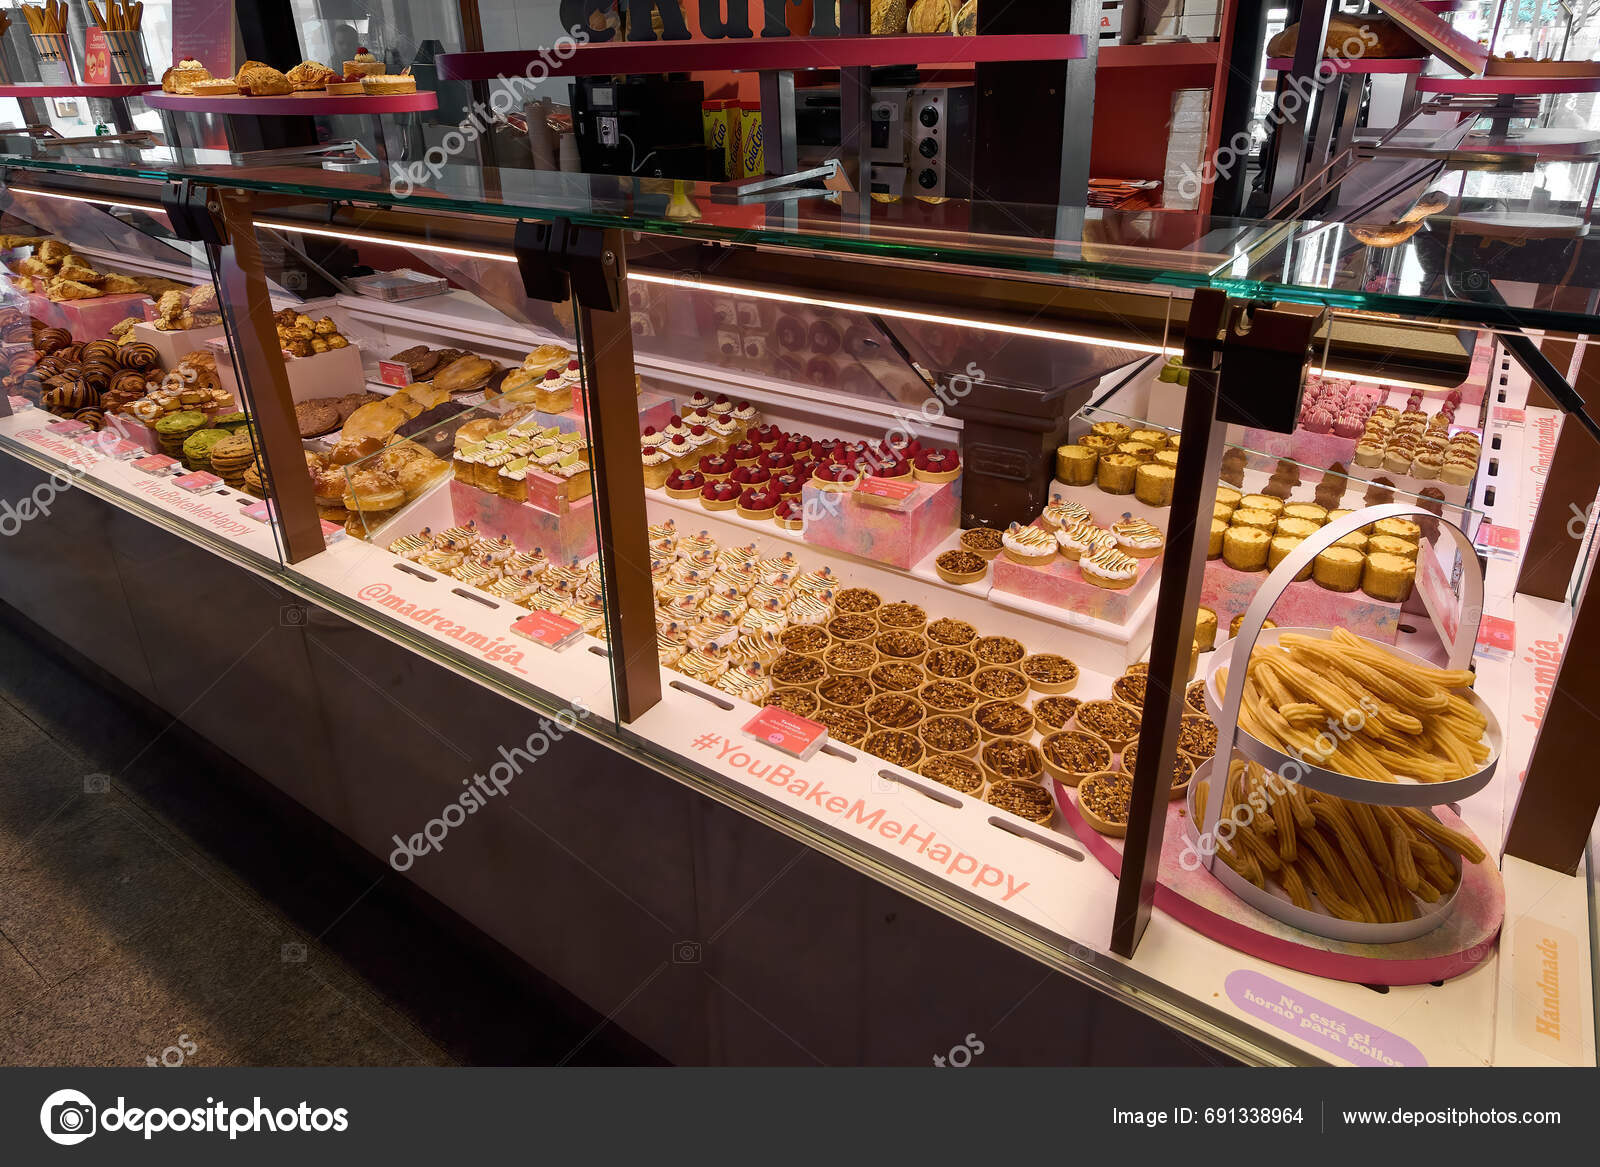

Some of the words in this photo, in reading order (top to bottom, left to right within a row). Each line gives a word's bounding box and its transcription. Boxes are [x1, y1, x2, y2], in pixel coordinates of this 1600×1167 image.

[135, 479, 256, 537] #YouBakeMeHappy
[690, 731, 1031, 902] #YouBakeMeHappy
[1243, 988, 1295, 1020] horno
[1300, 1017, 1341, 1043] para
[1536, 938, 1562, 1042] Handmade
[1278, 995, 1304, 1015] No
[1310, 1012, 1348, 1036] está
[1353, 1032, 1371, 1047] el
